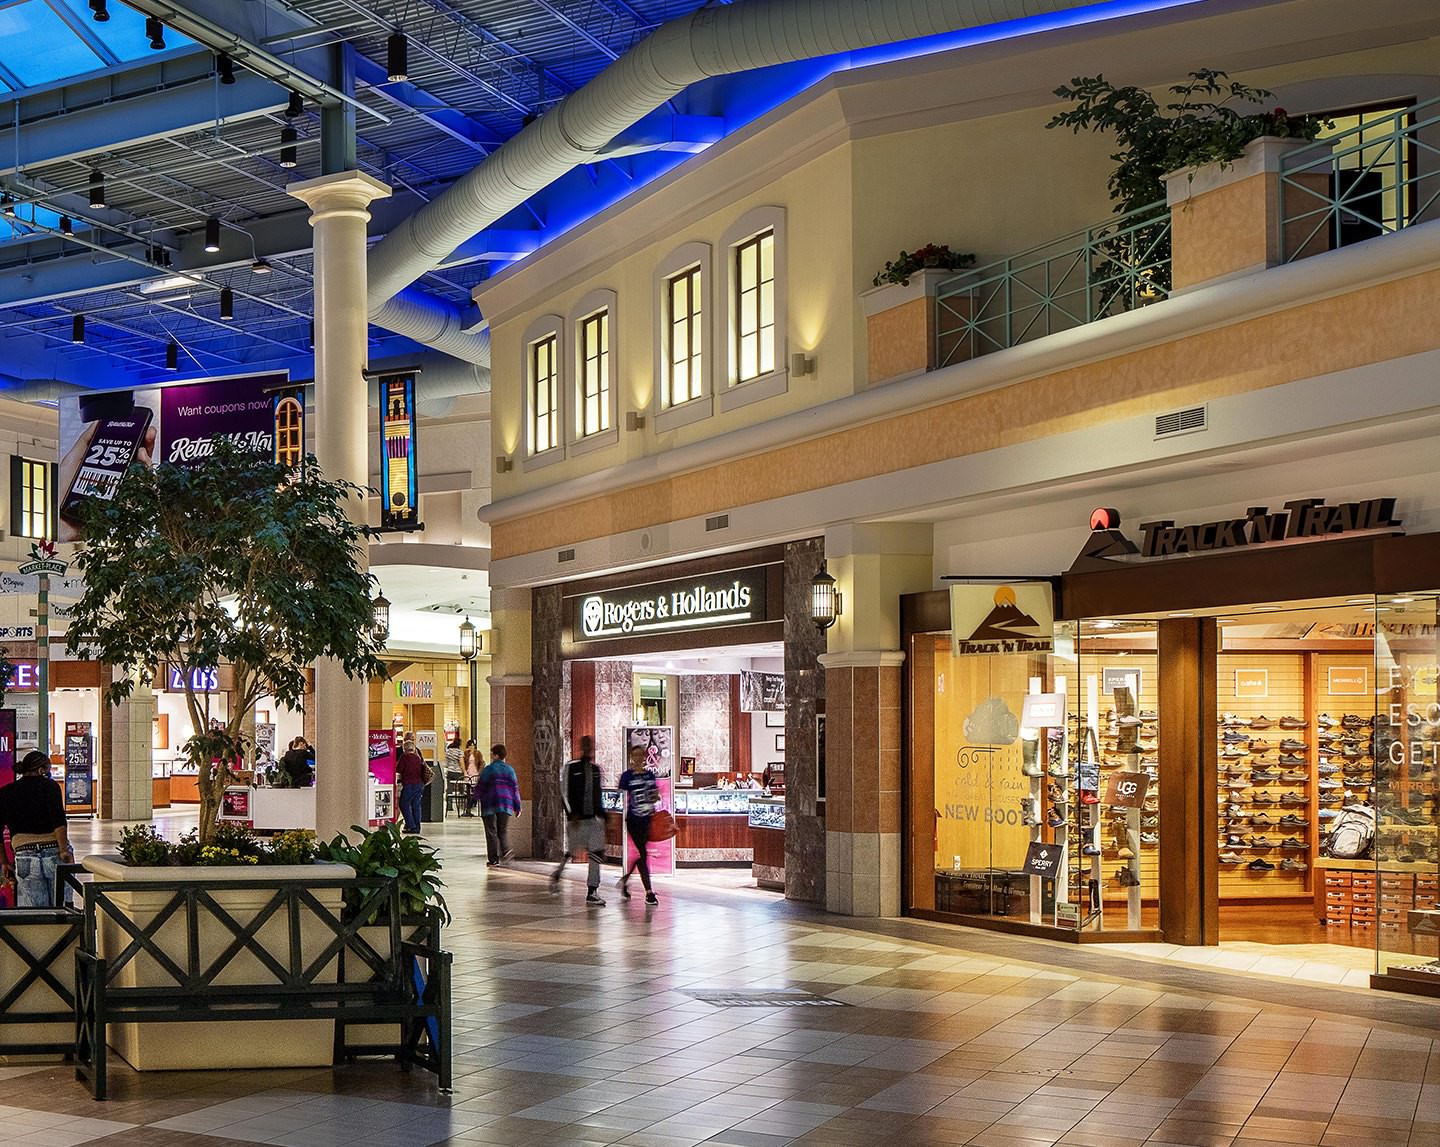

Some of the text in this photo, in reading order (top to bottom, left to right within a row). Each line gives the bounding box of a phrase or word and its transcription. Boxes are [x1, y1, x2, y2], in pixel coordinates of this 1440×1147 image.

[177, 405, 202, 417] Want
[204, 401, 246, 414] coupons
[98, 438, 113, 446] SAVE
[85, 445, 131, 467] 25%
[1139, 519, 1249, 557] TRACK
[1283, 497, 1403, 539] TRAIL
[603, 581, 751, 633] Rogers & Hollands
[959, 641, 1000, 654] TRACK
[1016, 639, 1053, 651] TRAIL
[1000, 777, 1024, 791] rain
[1117, 781, 1138, 795] UGG
[944, 803, 979, 822] NEW
